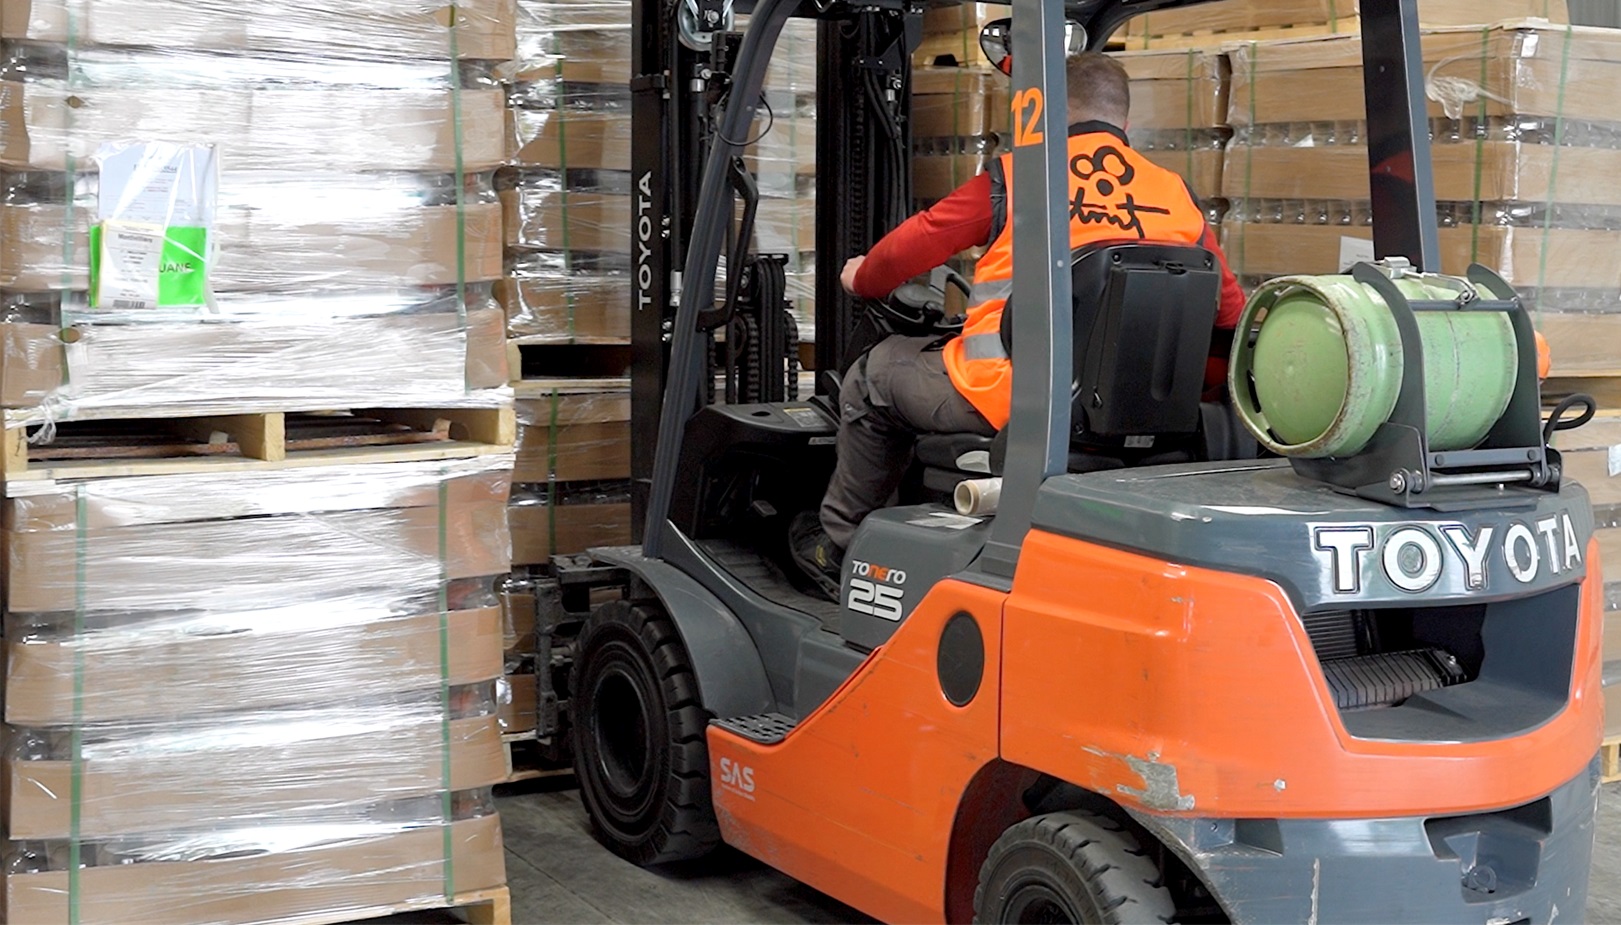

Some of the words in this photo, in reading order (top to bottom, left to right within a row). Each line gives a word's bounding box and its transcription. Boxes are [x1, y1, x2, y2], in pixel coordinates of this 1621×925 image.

[1011, 87, 1044, 147] 12
[638, 170, 652, 310] TOYOTA
[1314, 513, 1582, 594] TOYOTA
[848, 578, 904, 621] 25
[720, 757, 755, 793] SAS
